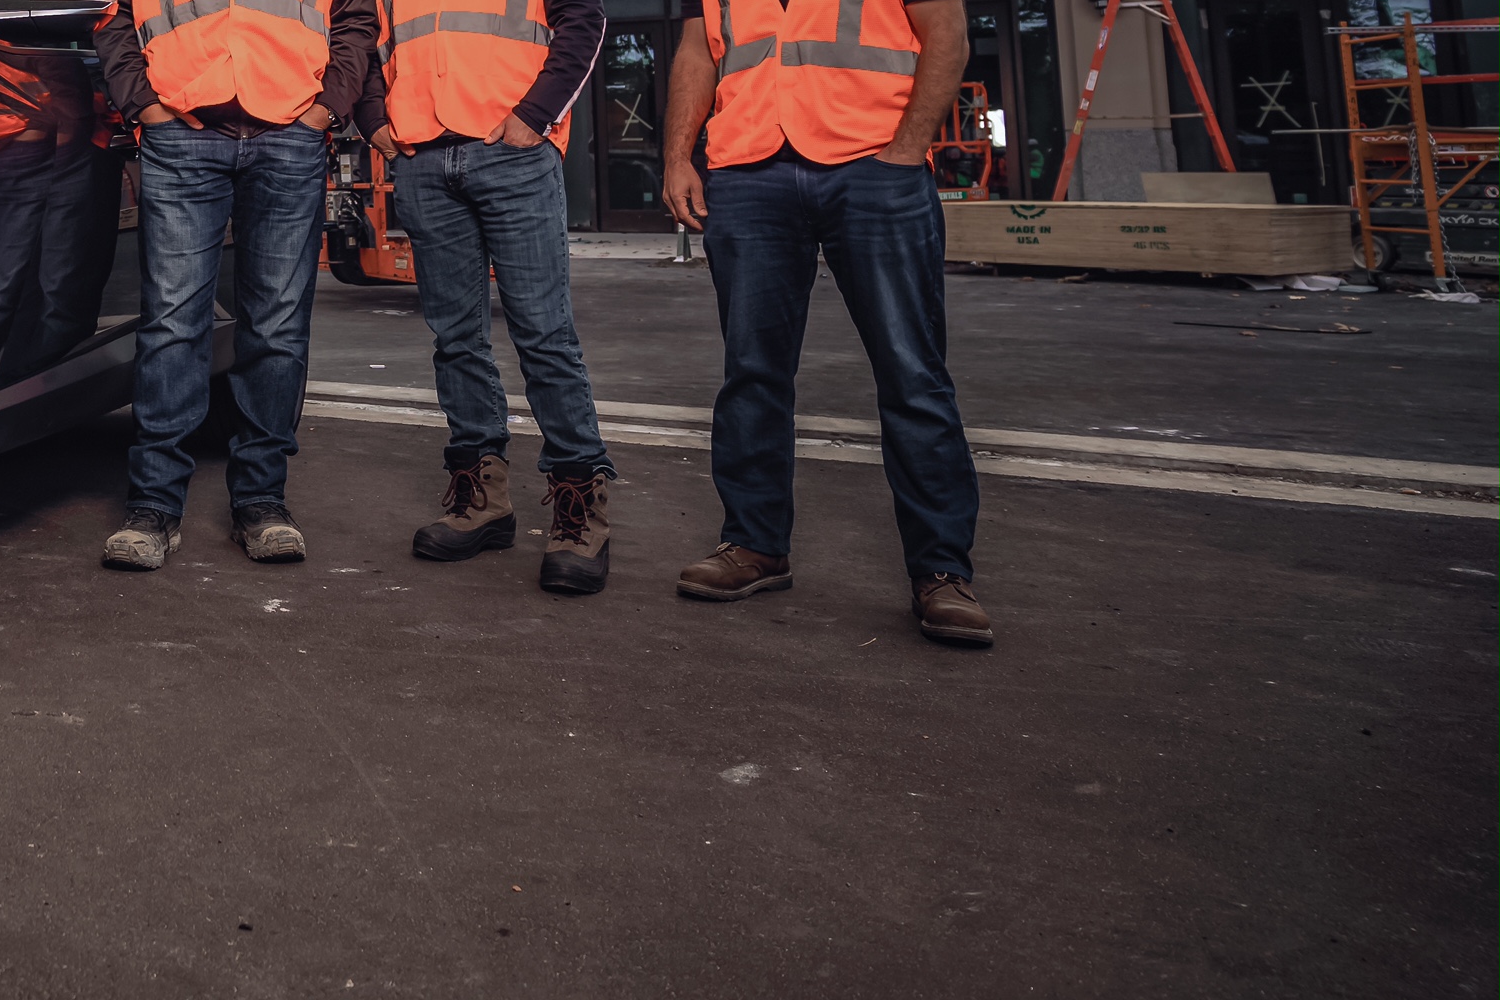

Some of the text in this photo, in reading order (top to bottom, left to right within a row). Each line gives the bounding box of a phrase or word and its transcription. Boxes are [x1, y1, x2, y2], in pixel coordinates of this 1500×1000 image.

[938, 191, 963, 200] ENTALS
[1440, 214, 1499, 226] KYJACK
[1006, 225, 1052, 234] MADE IN
[1017, 236, 1040, 245] USA
